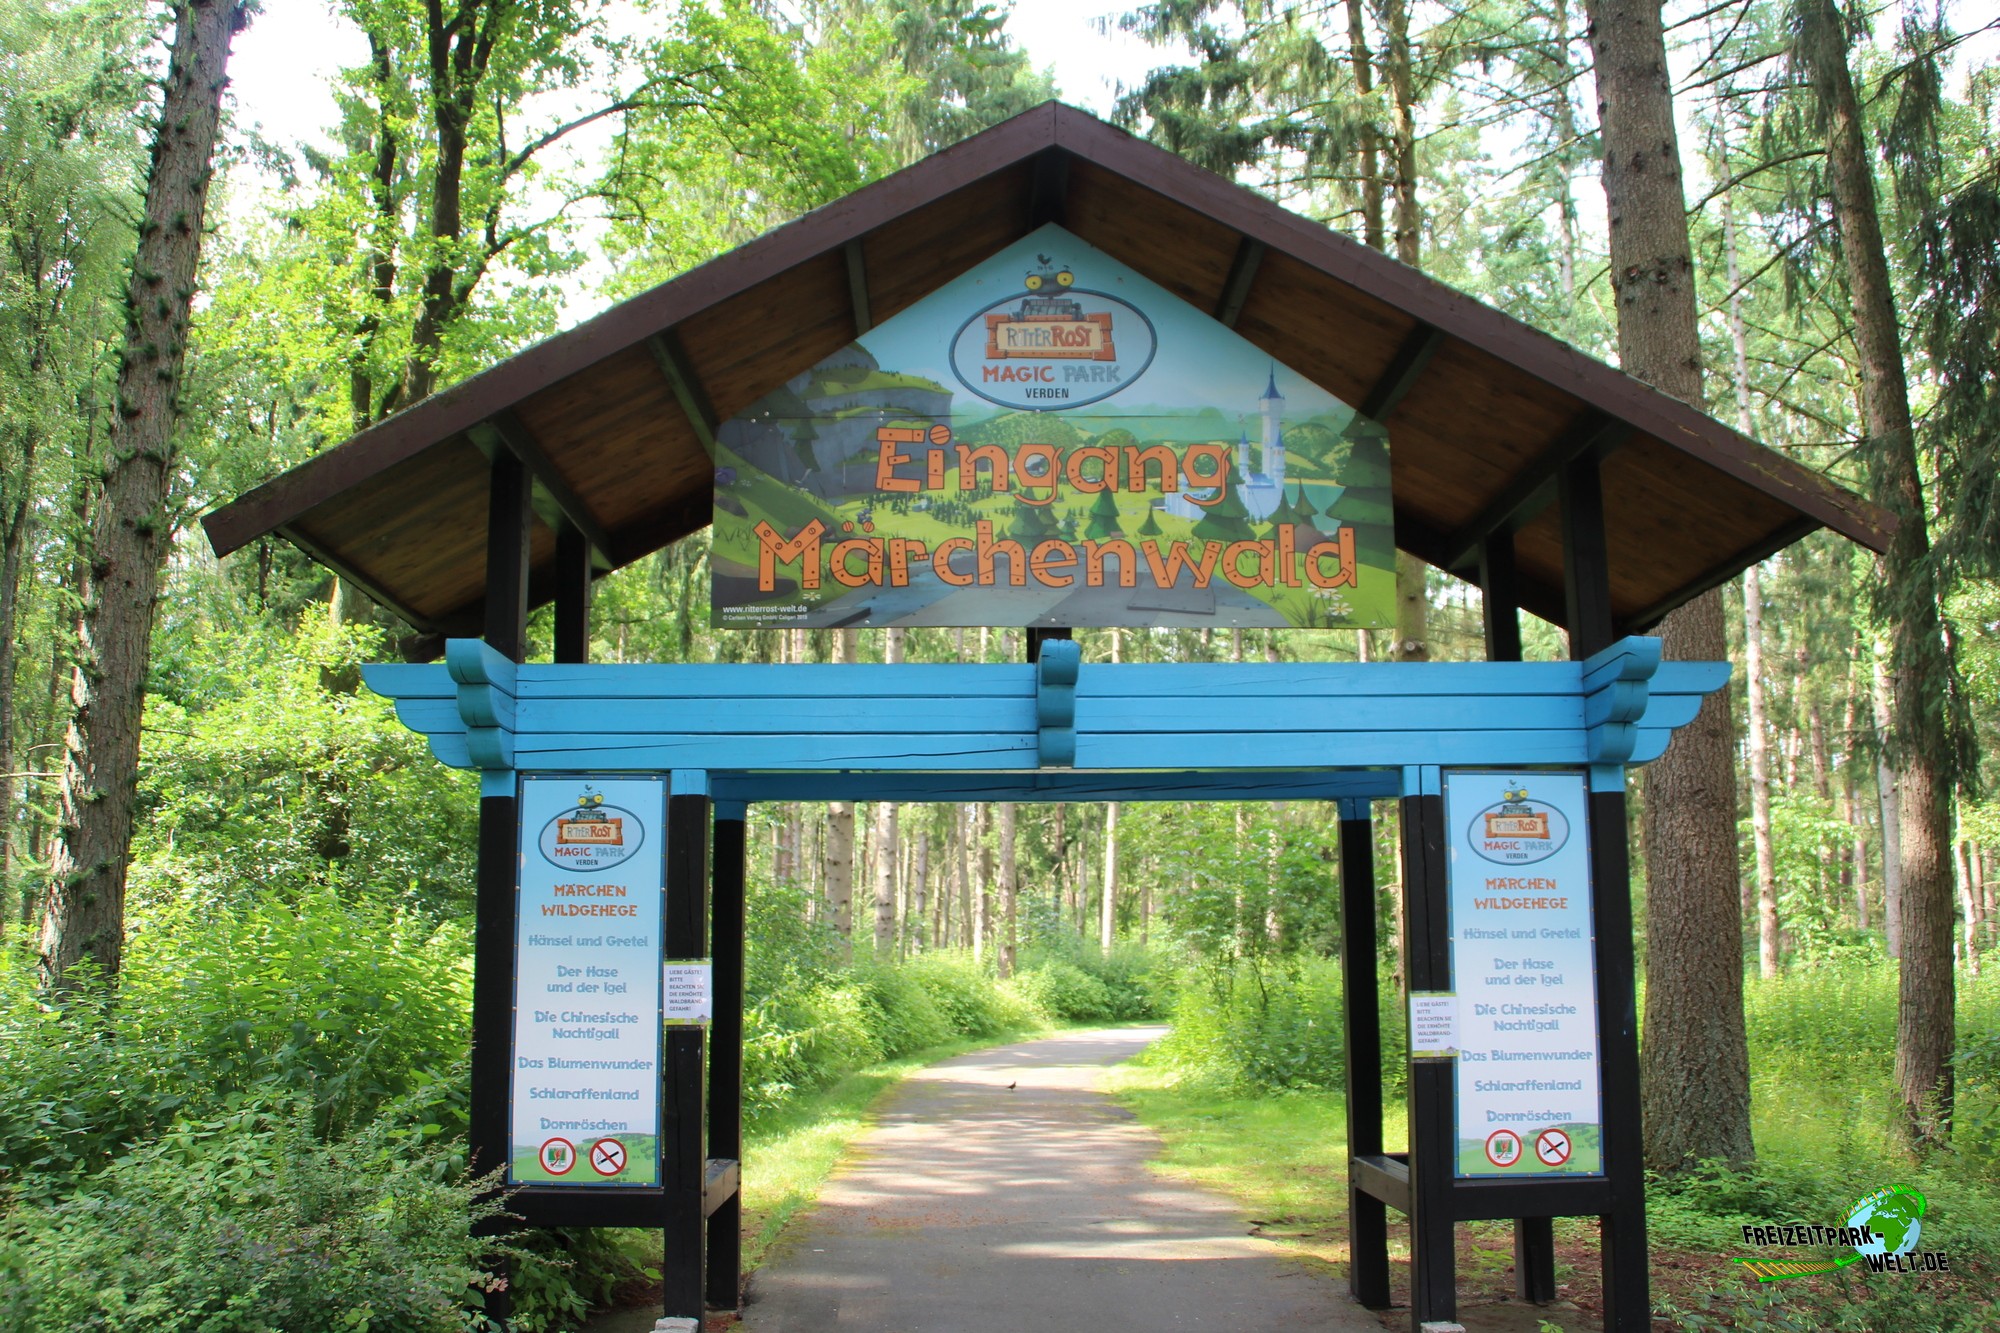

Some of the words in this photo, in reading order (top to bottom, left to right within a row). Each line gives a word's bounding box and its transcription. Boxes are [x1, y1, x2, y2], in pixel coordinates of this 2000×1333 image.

[982, 366, 1055, 382] MAGIC
[1063, 365, 1122, 382] PARK
[1025, 388, 1069, 398] VERDEN
[875, 424, 1232, 506] Eingang
[752, 517, 1357, 592] Märchenwald
[722, 604, 807, 613] www.ritterrost-welt.de
[1484, 841, 1520, 850] MAGIC
[1524, 841, 1553, 850] PARK
[554, 847, 592, 857] MAGIC
[595, 847, 625, 857] PARK
[1486, 876, 1556, 890] MÄRCHEN
[554, 883, 626, 896] MÄRCHEN
[1474, 898, 1568, 910] WILDGEHEGE
[541, 904, 637, 917] WILDGEHEGE
[1464, 928, 1508, 939] Hänsel
[1512, 928, 1536, 939] und
[1540, 928, 1581, 939] Gretel
[528, 935, 572, 947] Hänsel
[576, 936, 602, 947] und
[606, 936, 648, 947] Gretel
[1494, 958, 1518, 970] Der
[1523, 958, 1554, 970] Hase
[557, 965, 581, 977] Der
[586, 965, 618, 977] Hase
[1486, 975, 1511, 985] und
[1515, 975, 1537, 985] der
[1541, 974, 1563, 986] Igel
[547, 983, 572, 993] und
[576, 983, 599, 993] der
[604, 982, 626, 995] Igel
[1474, 1003, 1496, 1016] Die
[1501, 1003, 1576, 1015] Chinesische
[534, 1010, 556, 1023] Die
[561, 1011, 638, 1023] Chinesische
[1494, 1019, 1559, 1032] Nachtigall
[552, 1028, 619, 1040] Nachtigall
[1462, 1050, 1487, 1062] Das
[1491, 1050, 1593, 1062] Blumenwunder
[518, 1057, 544, 1068] Das
[548, 1057, 653, 1070] Blumenwunder
[1474, 1080, 1582, 1092] Schlaraffenland
[530, 1088, 639, 1100] Schlaraffenland
[1486, 1110, 1571, 1122] Dornröschen
[540, 1118, 627, 1131] Dornröschen
